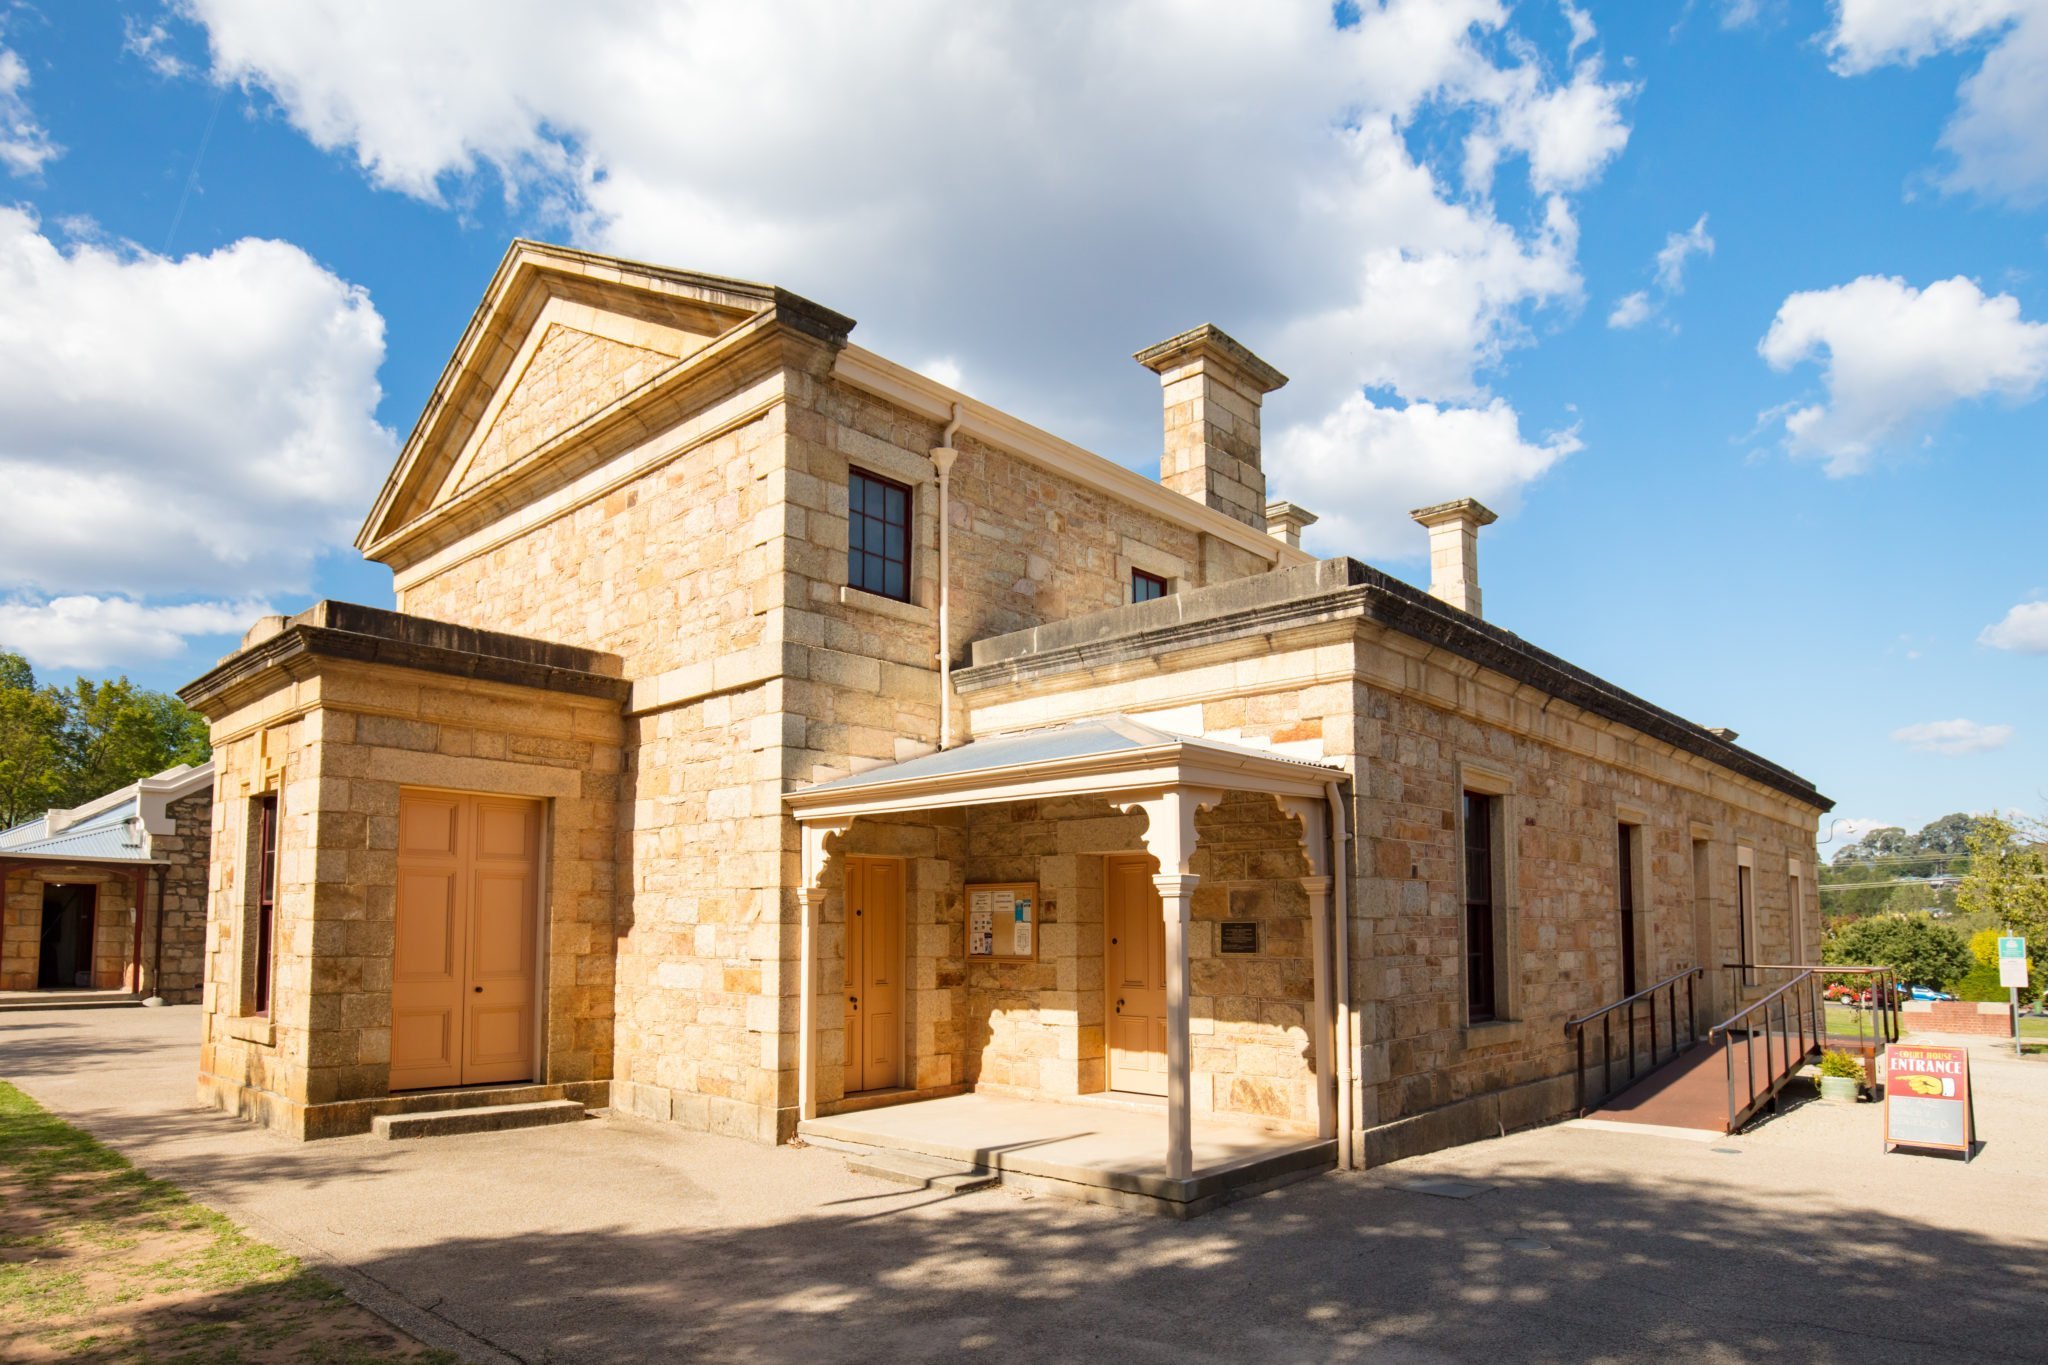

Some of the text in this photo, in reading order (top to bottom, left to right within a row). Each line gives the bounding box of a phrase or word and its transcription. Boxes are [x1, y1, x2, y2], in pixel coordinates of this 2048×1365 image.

[1899, 1050, 1953, 1060] COURT HOUSE
[1891, 1057, 1962, 1075] ENTRANCE
